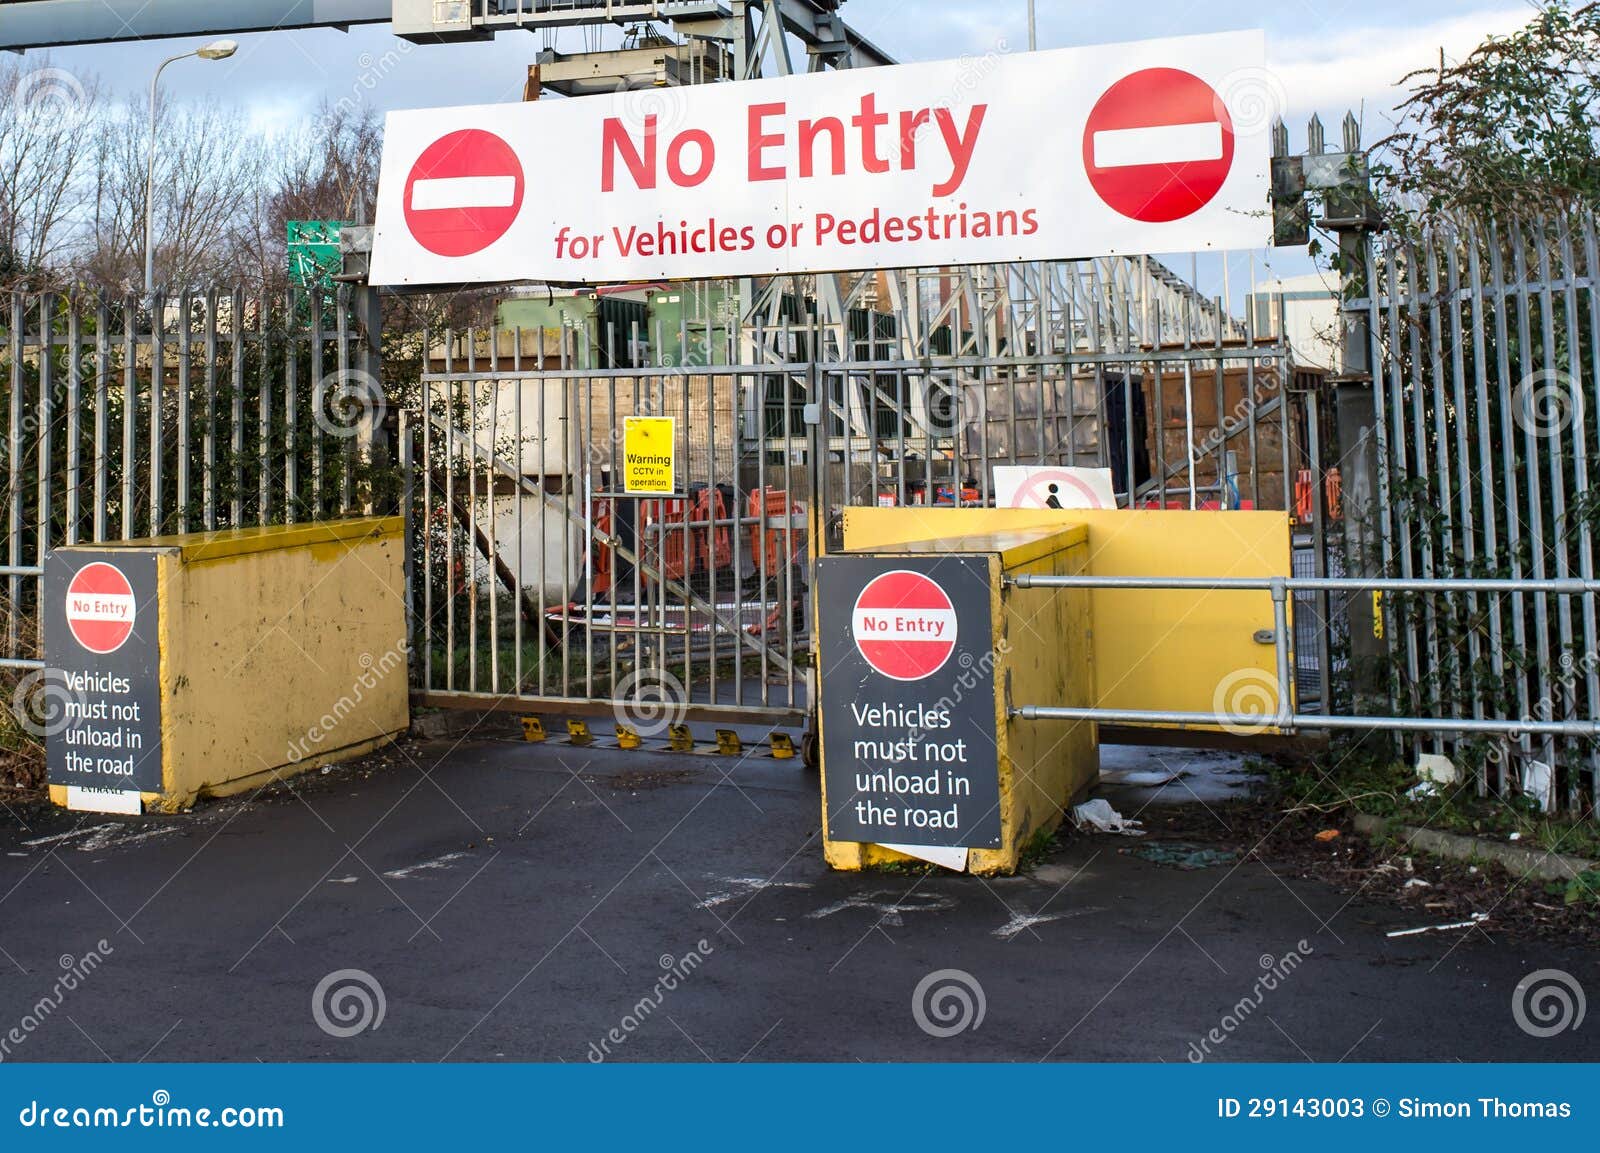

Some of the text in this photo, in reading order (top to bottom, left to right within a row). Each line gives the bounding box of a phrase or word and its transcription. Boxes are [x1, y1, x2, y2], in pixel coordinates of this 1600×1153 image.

[601, 92, 988, 197] No Entry
[554, 202, 1039, 259] for Vehicles or Pedestrians
[627, 454, 671, 467] Warning
[633, 467, 664, 475] CCTV in
[630, 479, 667, 487] operation
[73, 600, 128, 617] No Entry
[863, 617, 945, 637] No Entry
[63, 670, 130, 694] Vehicles
[65, 700, 141, 721] must not
[851, 702, 951, 729] Vehicles
[65, 725, 142, 749] unload in
[854, 737, 967, 762] must not
[65, 751, 134, 776] the road
[855, 768, 970, 796] unload in
[855, 800, 958, 829] the road
